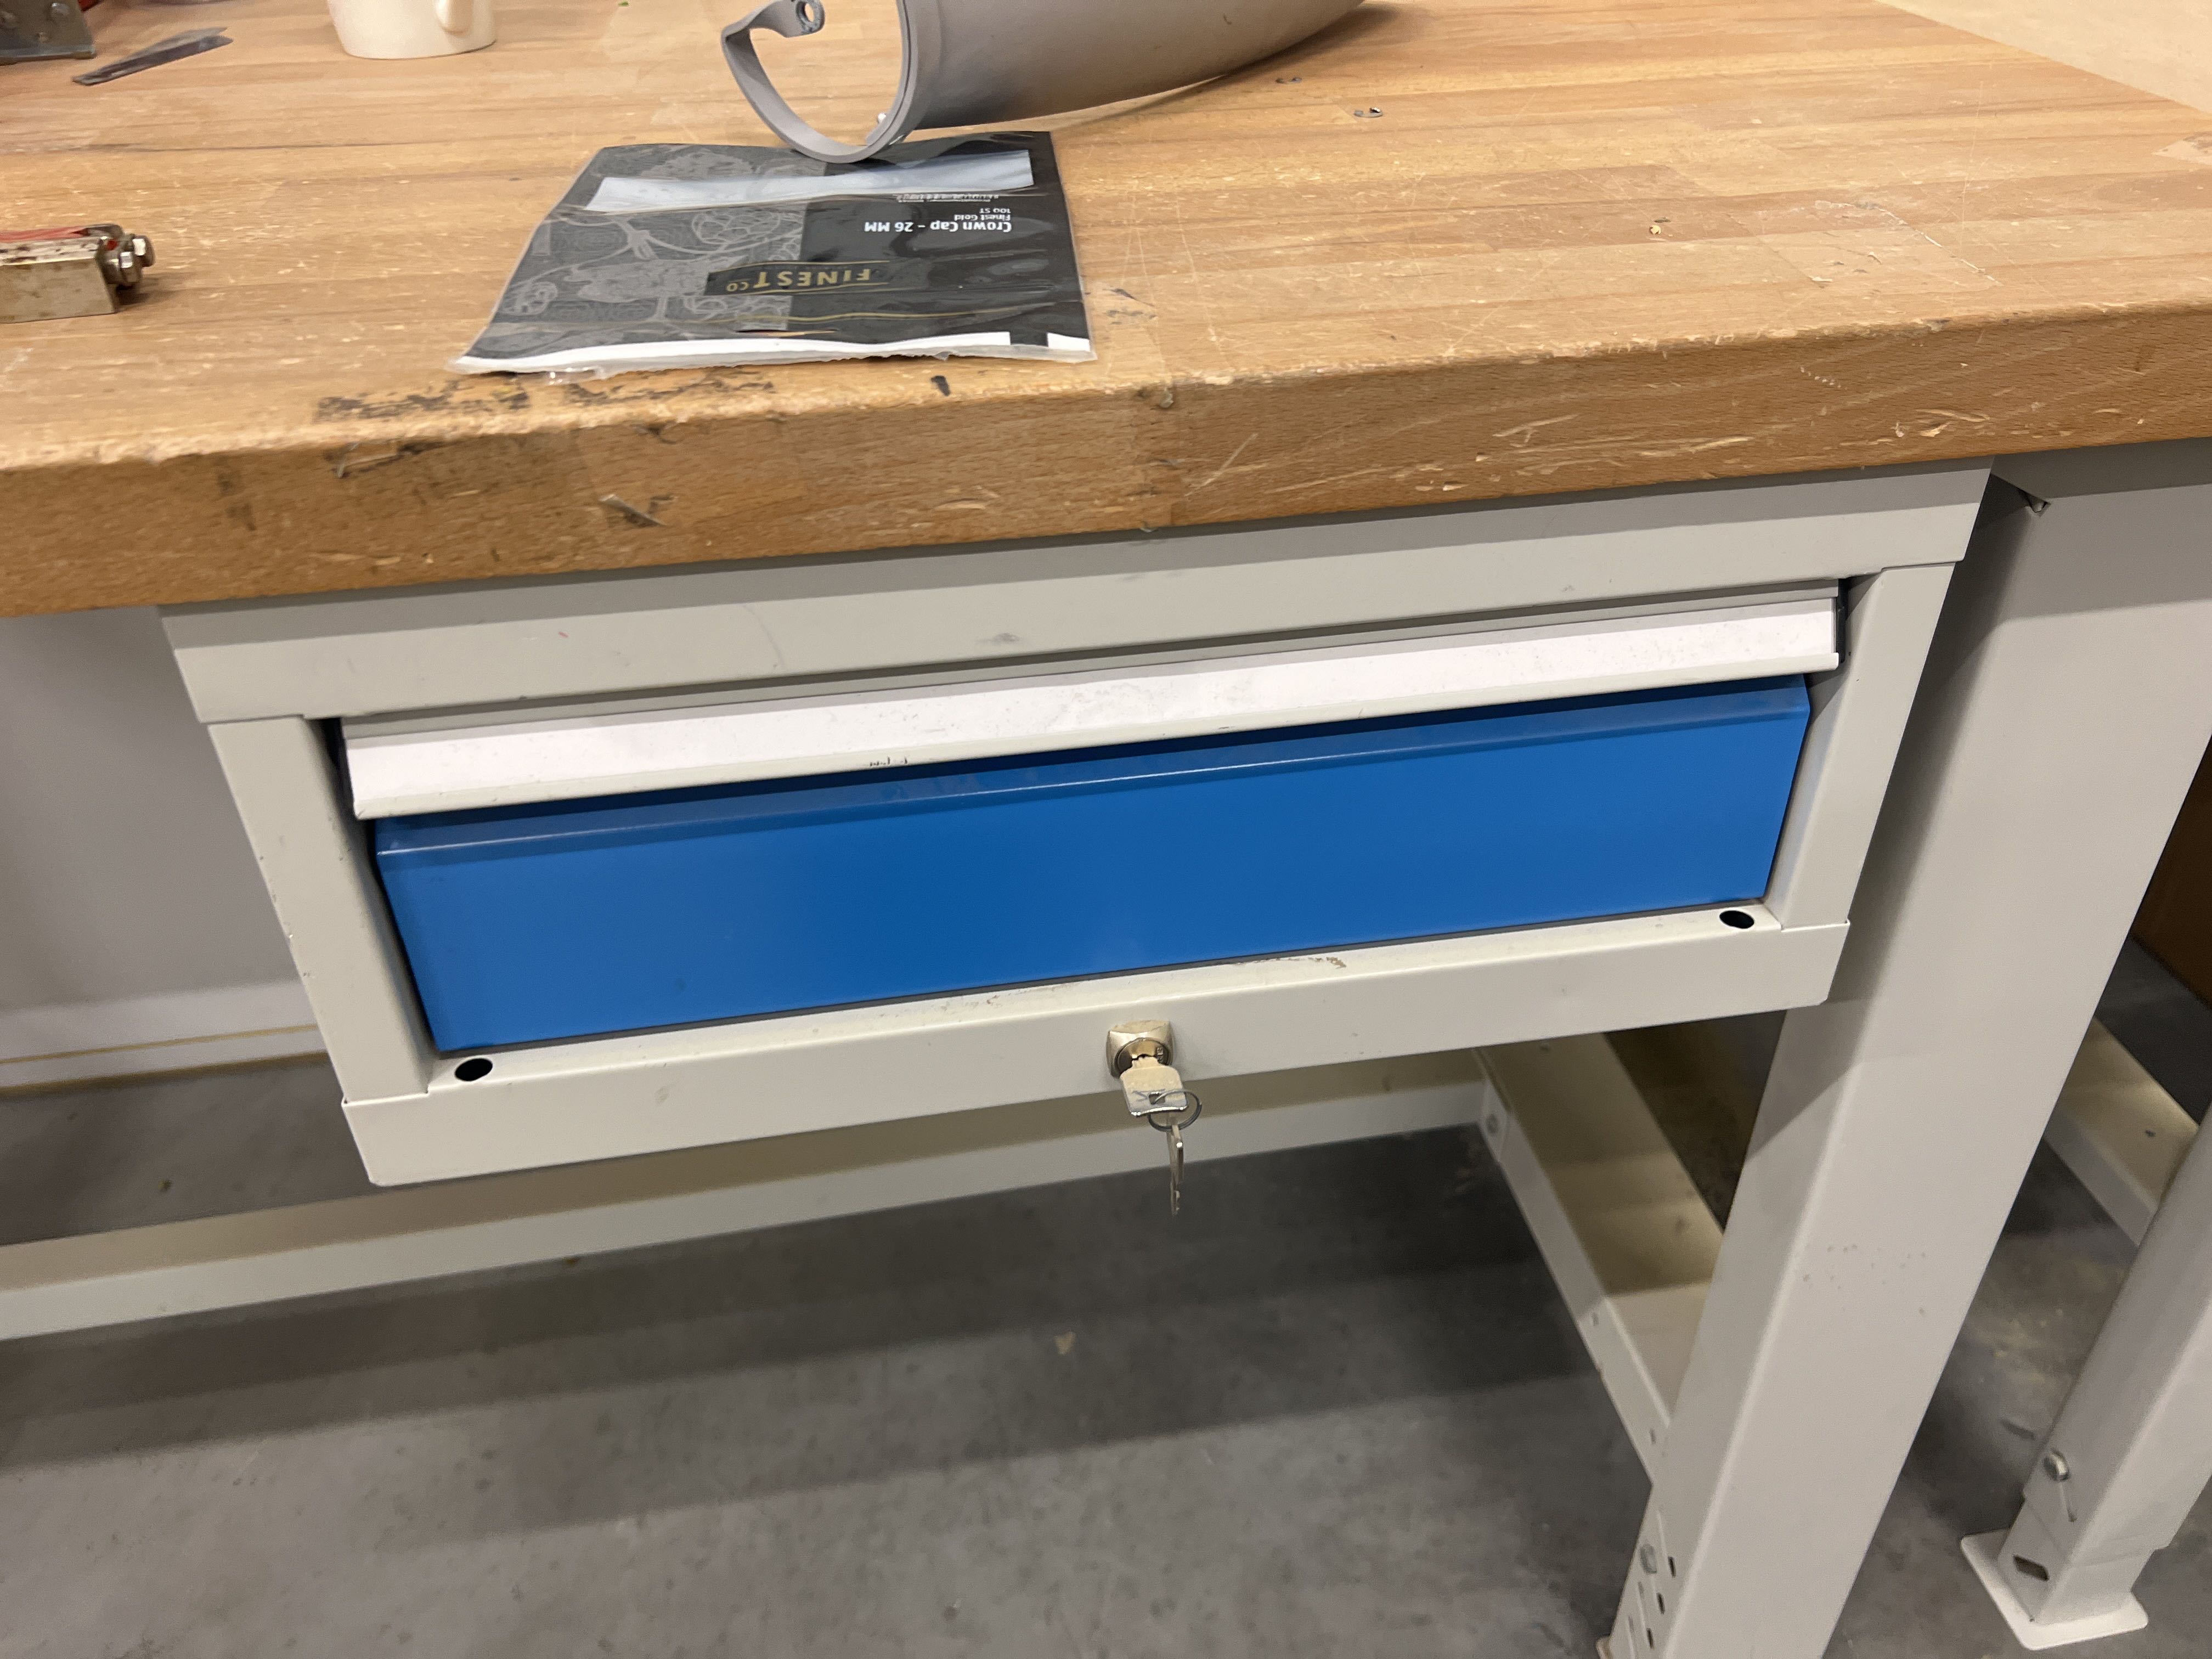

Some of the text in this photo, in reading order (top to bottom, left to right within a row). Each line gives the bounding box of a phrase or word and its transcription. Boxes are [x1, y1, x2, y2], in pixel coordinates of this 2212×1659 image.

[864, 222, 891, 232] MM
[895, 222, 914, 233] 26
[930, 220, 958, 232] Cap
[963, 222, 1012, 233] Crown
[754, 269, 870, 287] FINEST
